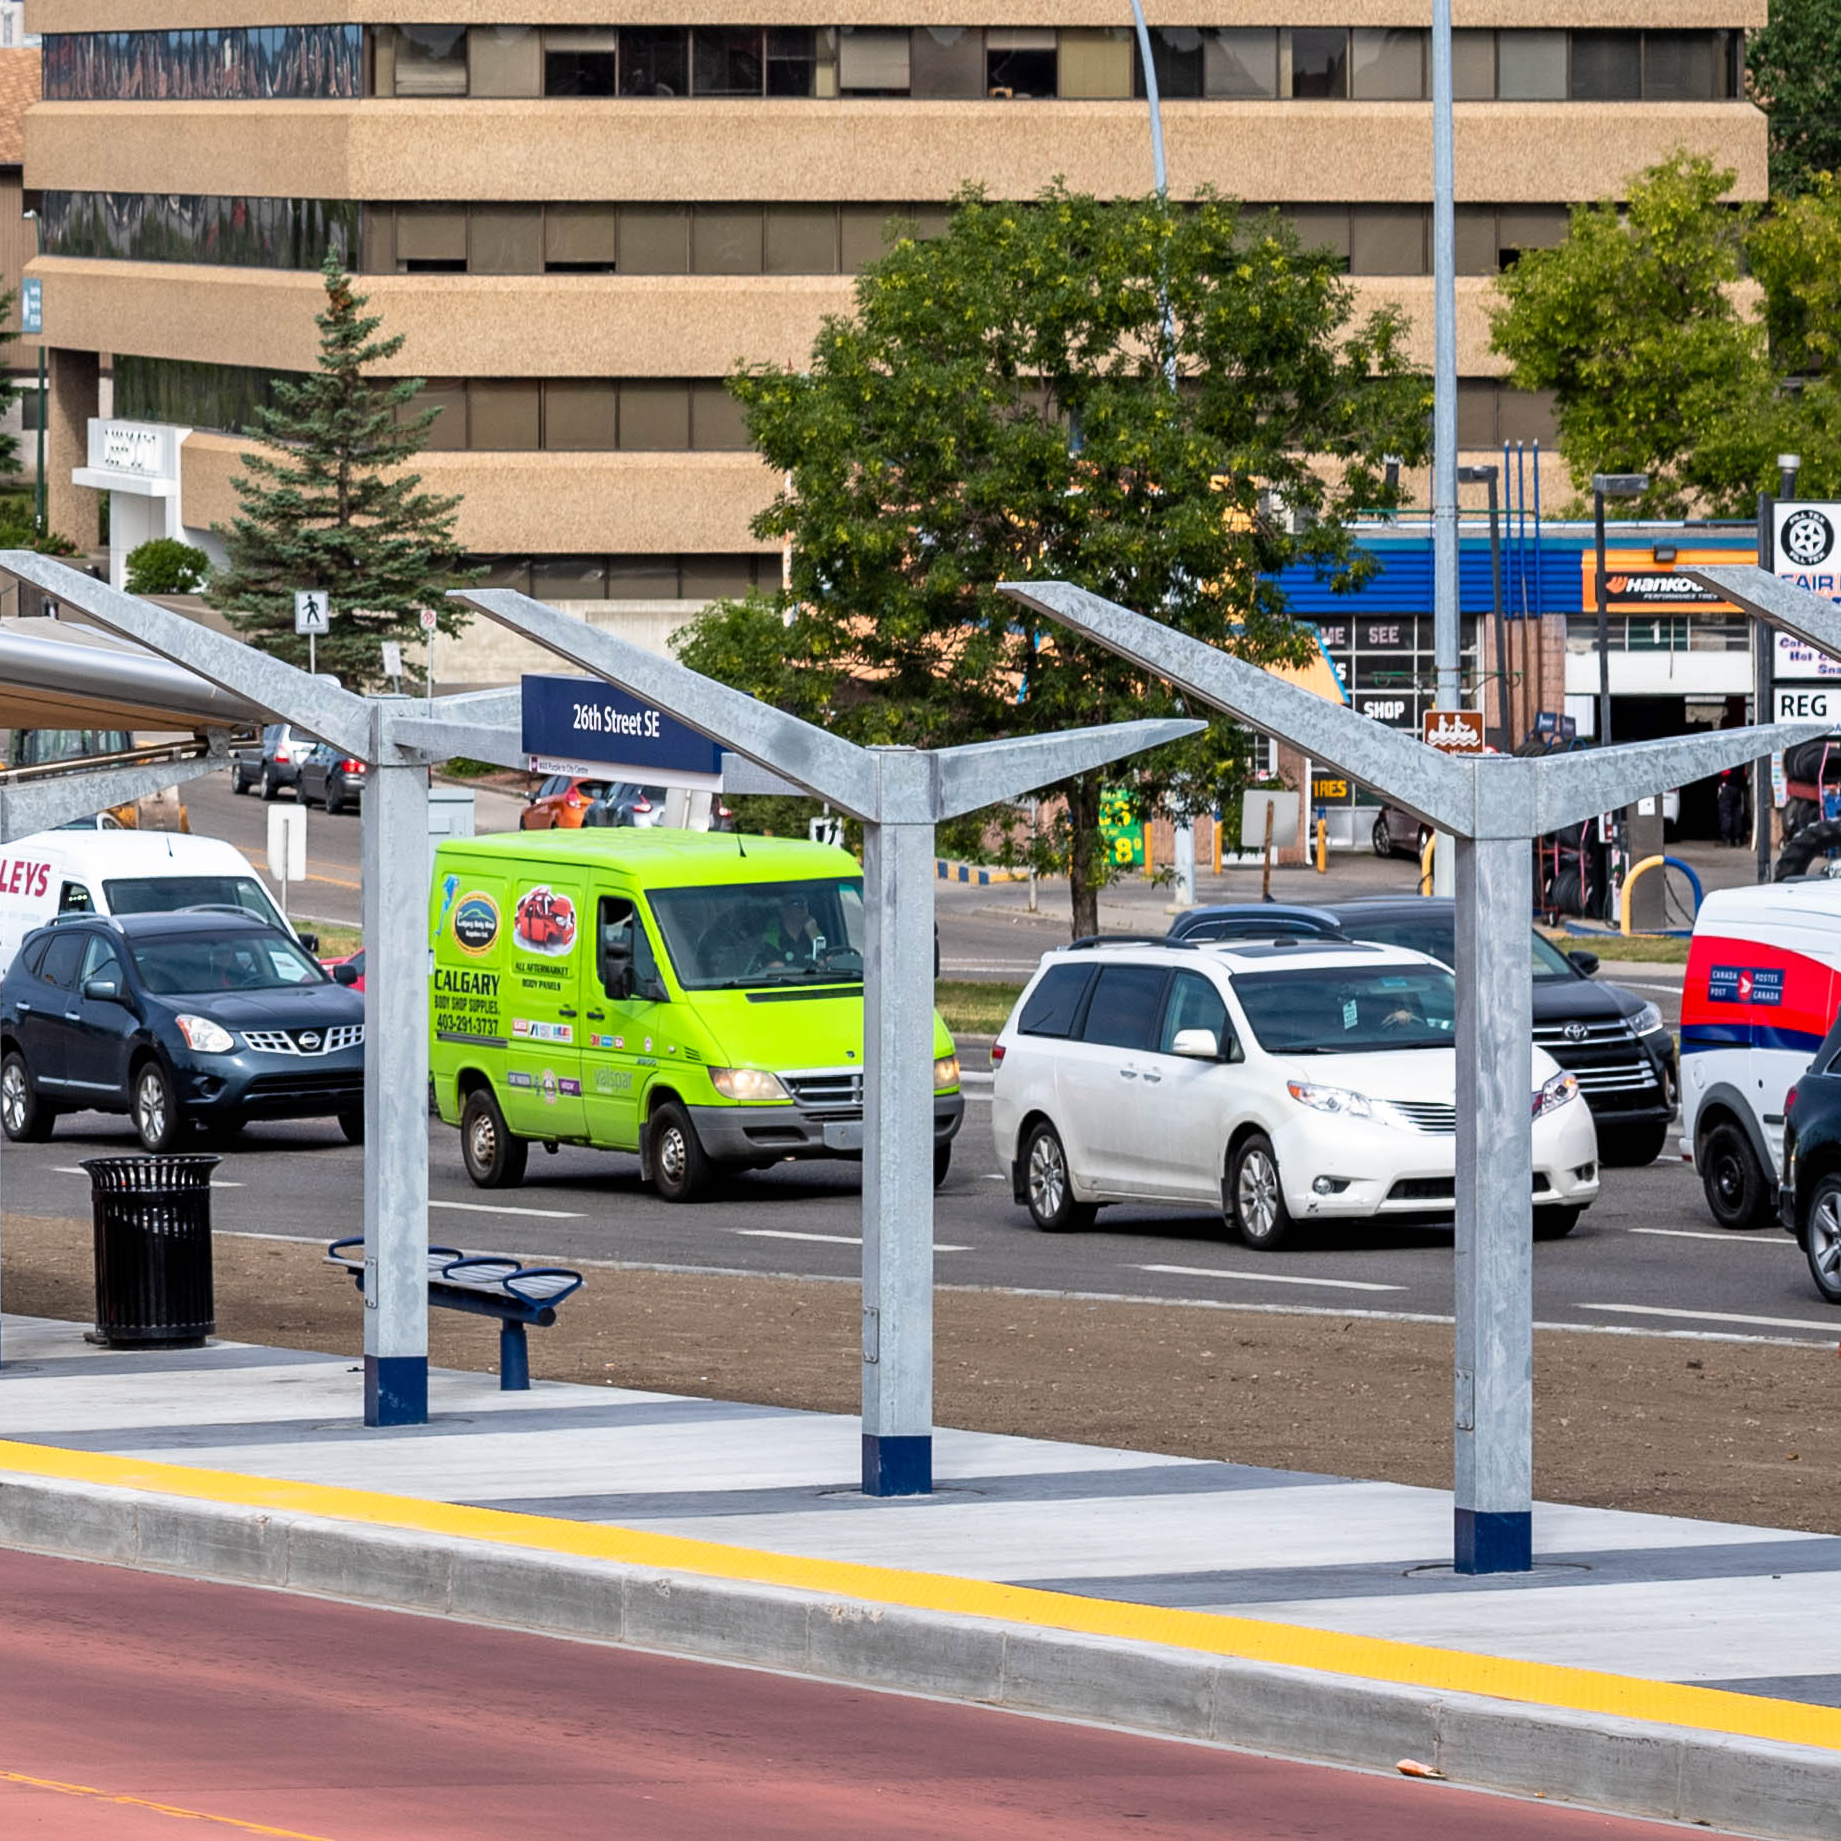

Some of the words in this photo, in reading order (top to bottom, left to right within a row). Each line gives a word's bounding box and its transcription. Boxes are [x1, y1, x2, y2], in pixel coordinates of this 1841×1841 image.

[1368, 625, 1400, 645] SEE
[1650, 620, 1661, 644] 1
[1363, 700, 1405, 720] SHOP
[1780, 694, 1828, 718] REG
[572, 703, 602, 732] 26th
[603, 705, 642, 737] Street
[643, 710, 661, 738] SE
[515, 962, 526, 972] ALL
[527, 963, 569, 976] AFTERMARKET
[1712, 969, 1738, 981] CANADA
[1755, 973, 1779, 983] POSTES
[434, 969, 501, 997] CALGARY
[522, 978, 537, 989] BODY
[538, 980, 561, 991] PANELS
[1710, 987, 1727, 997] POST
[434, 995, 450, 1009] BODY
[452, 997, 468, 1011] SHOP
[1752, 990, 1780, 1001] CANADA
[437, 1013, 499, 1035] 403-291-3737
[594, 1065, 633, 1089] valspar
